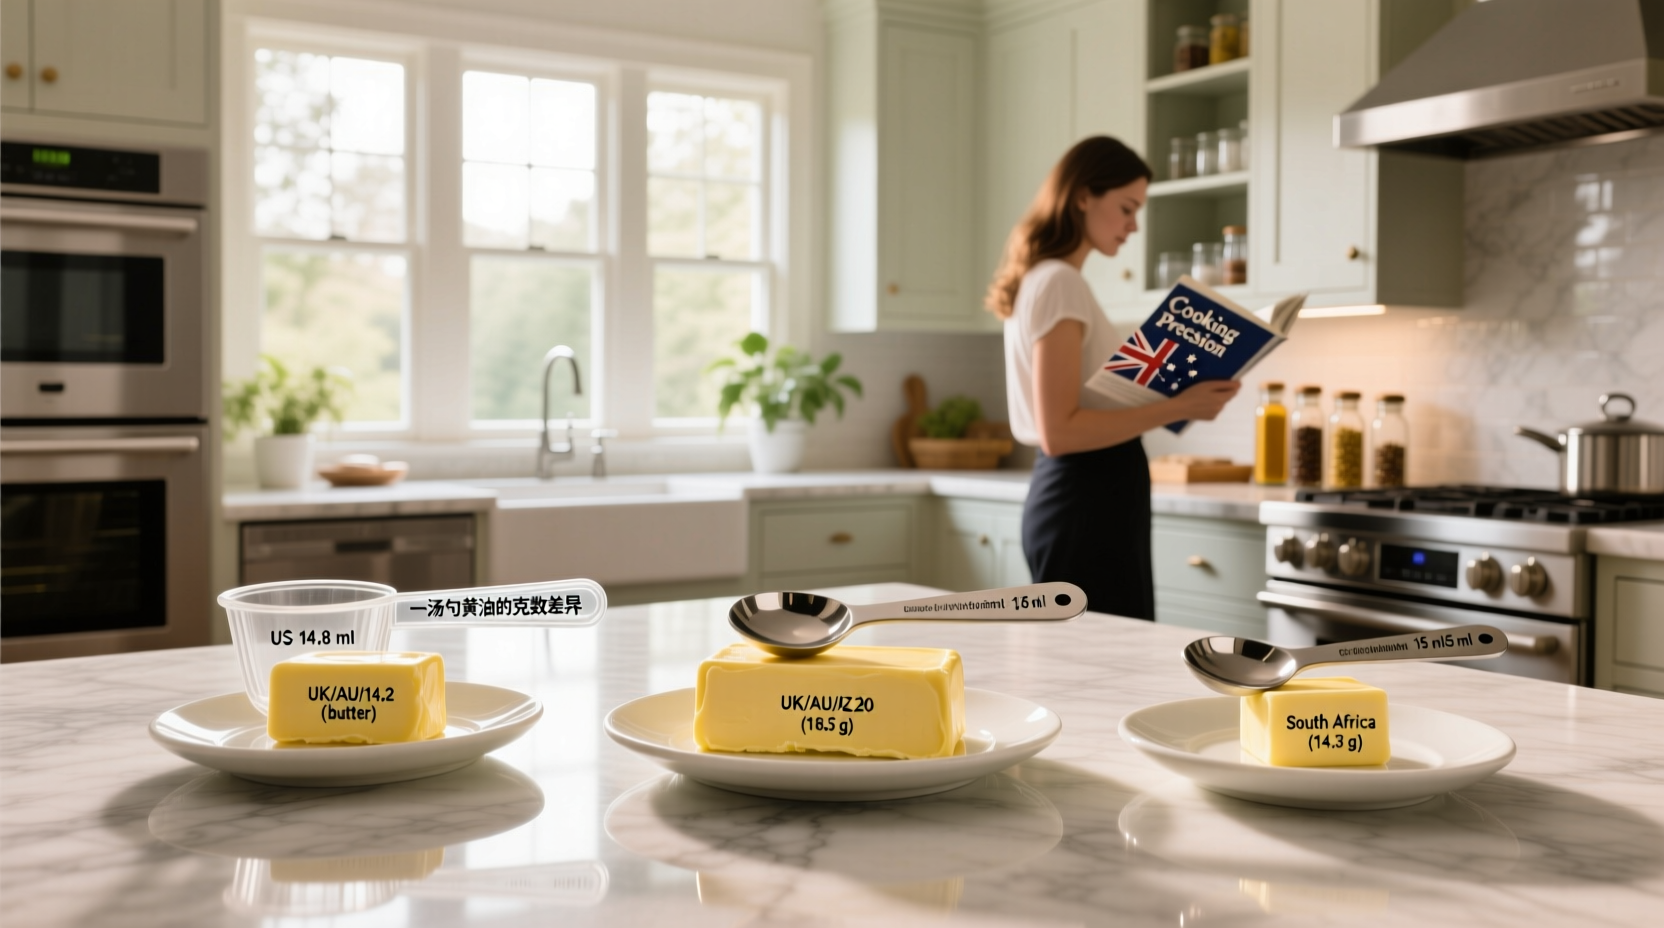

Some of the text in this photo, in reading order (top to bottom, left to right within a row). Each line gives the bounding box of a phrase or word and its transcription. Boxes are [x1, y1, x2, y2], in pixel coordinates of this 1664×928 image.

[1169, 296, 1240, 345] Cooking
[270, 629, 355, 646] US 14.8 ml
[1413, 636, 1428, 650] 15
[1457, 632, 1473, 647] ml
[308, 686, 395, 702] UK/AU/14.2
[321, 704, 377, 724] (butter)
[1286, 713, 1376, 730] South Africa
[801, 716, 854, 737] (18.5 g)
[1308, 733, 1363, 753] (14.3 g)
